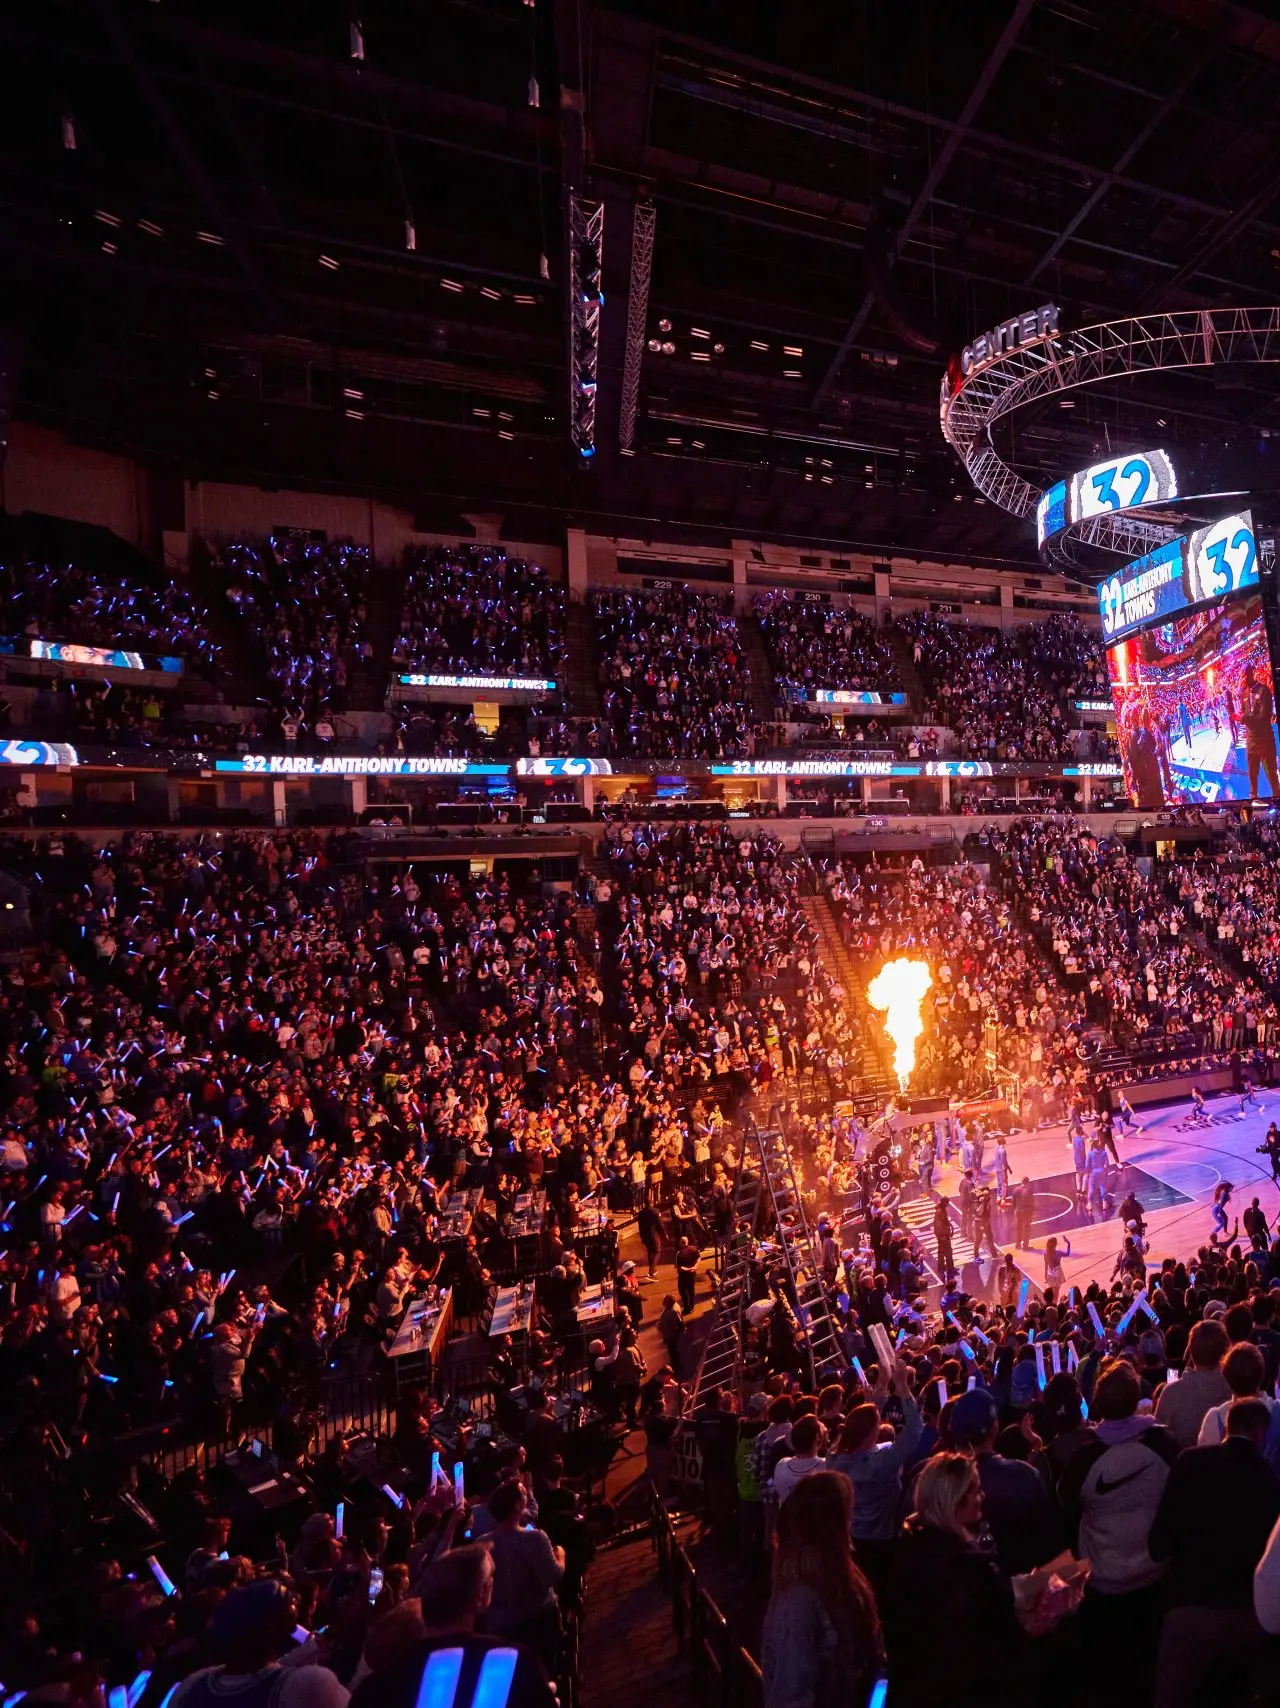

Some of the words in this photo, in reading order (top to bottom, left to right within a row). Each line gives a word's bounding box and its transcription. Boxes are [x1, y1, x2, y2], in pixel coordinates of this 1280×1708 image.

[962, 303, 1060, 376] CENTER
[1092, 459, 1152, 511] 32
[1206, 528, 1259, 600] 32
[1101, 577, 1126, 634] 32
[1123, 589, 1157, 626] TOWNS
[410, 675, 426, 685] 32
[428, 676, 510, 688] KARL-ANTHONY
[242, 755, 267, 772] 32
[270, 757, 408, 773] KARL-ANTHONY
[408, 758, 467, 773] TOWNS
[732, 762, 750, 774] 32
[753, 762, 848, 775] KARL-ANTHONY
[850, 762, 892, 775] TOWNS
[1078, 764, 1092, 775] 32
